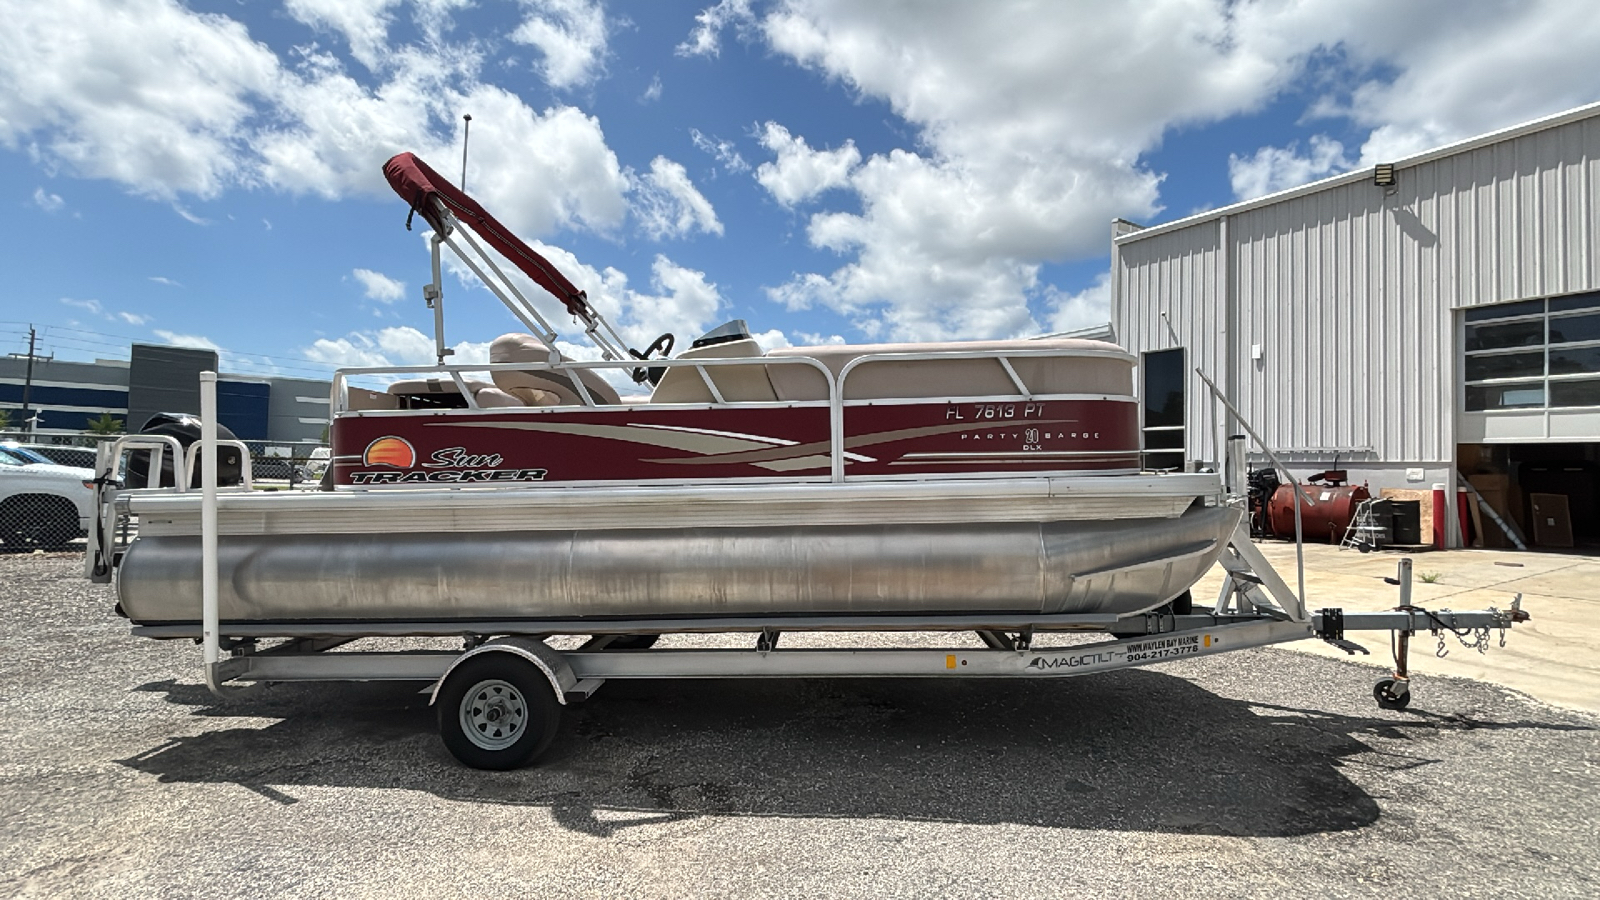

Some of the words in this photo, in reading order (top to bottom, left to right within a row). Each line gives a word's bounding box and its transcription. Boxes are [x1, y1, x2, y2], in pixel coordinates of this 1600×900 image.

[946, 406, 964, 419] FL
[974, 404, 1015, 419] 7613
[1024, 403, 1046, 417] PT
[1025, 428, 1039, 443] 20
[421, 446, 503, 468] Sun
[350, 468, 548, 484] TRACKER
[1166, 638, 1178, 648] BAY
[1178, 635, 1199, 646] MARINE
[1042, 651, 1115, 669] MAGICTILT
